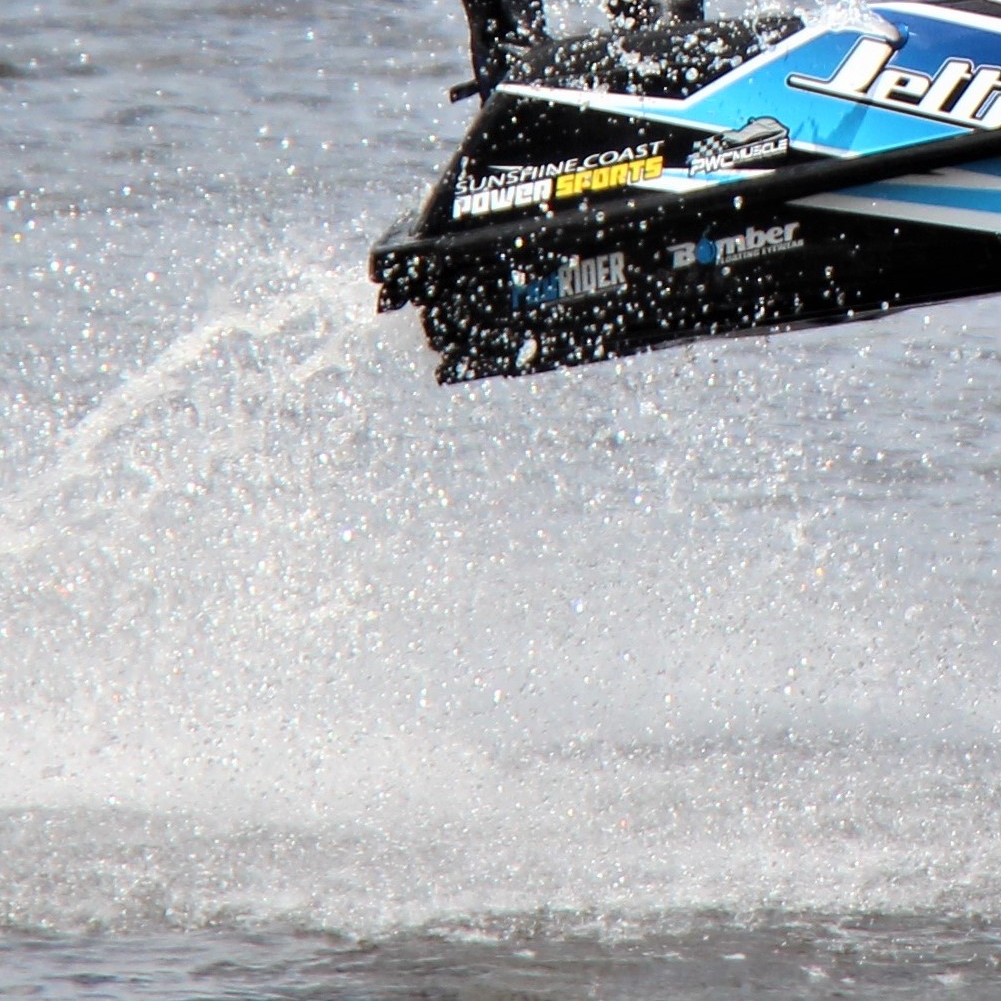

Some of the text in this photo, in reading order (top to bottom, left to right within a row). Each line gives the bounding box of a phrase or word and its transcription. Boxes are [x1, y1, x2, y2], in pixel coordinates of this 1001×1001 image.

[452, 156, 663, 220] POWER SPORTS
[453, 140, 664, 196] SUNSHINE COAST
[666, 221, 800, 269] Bomber
